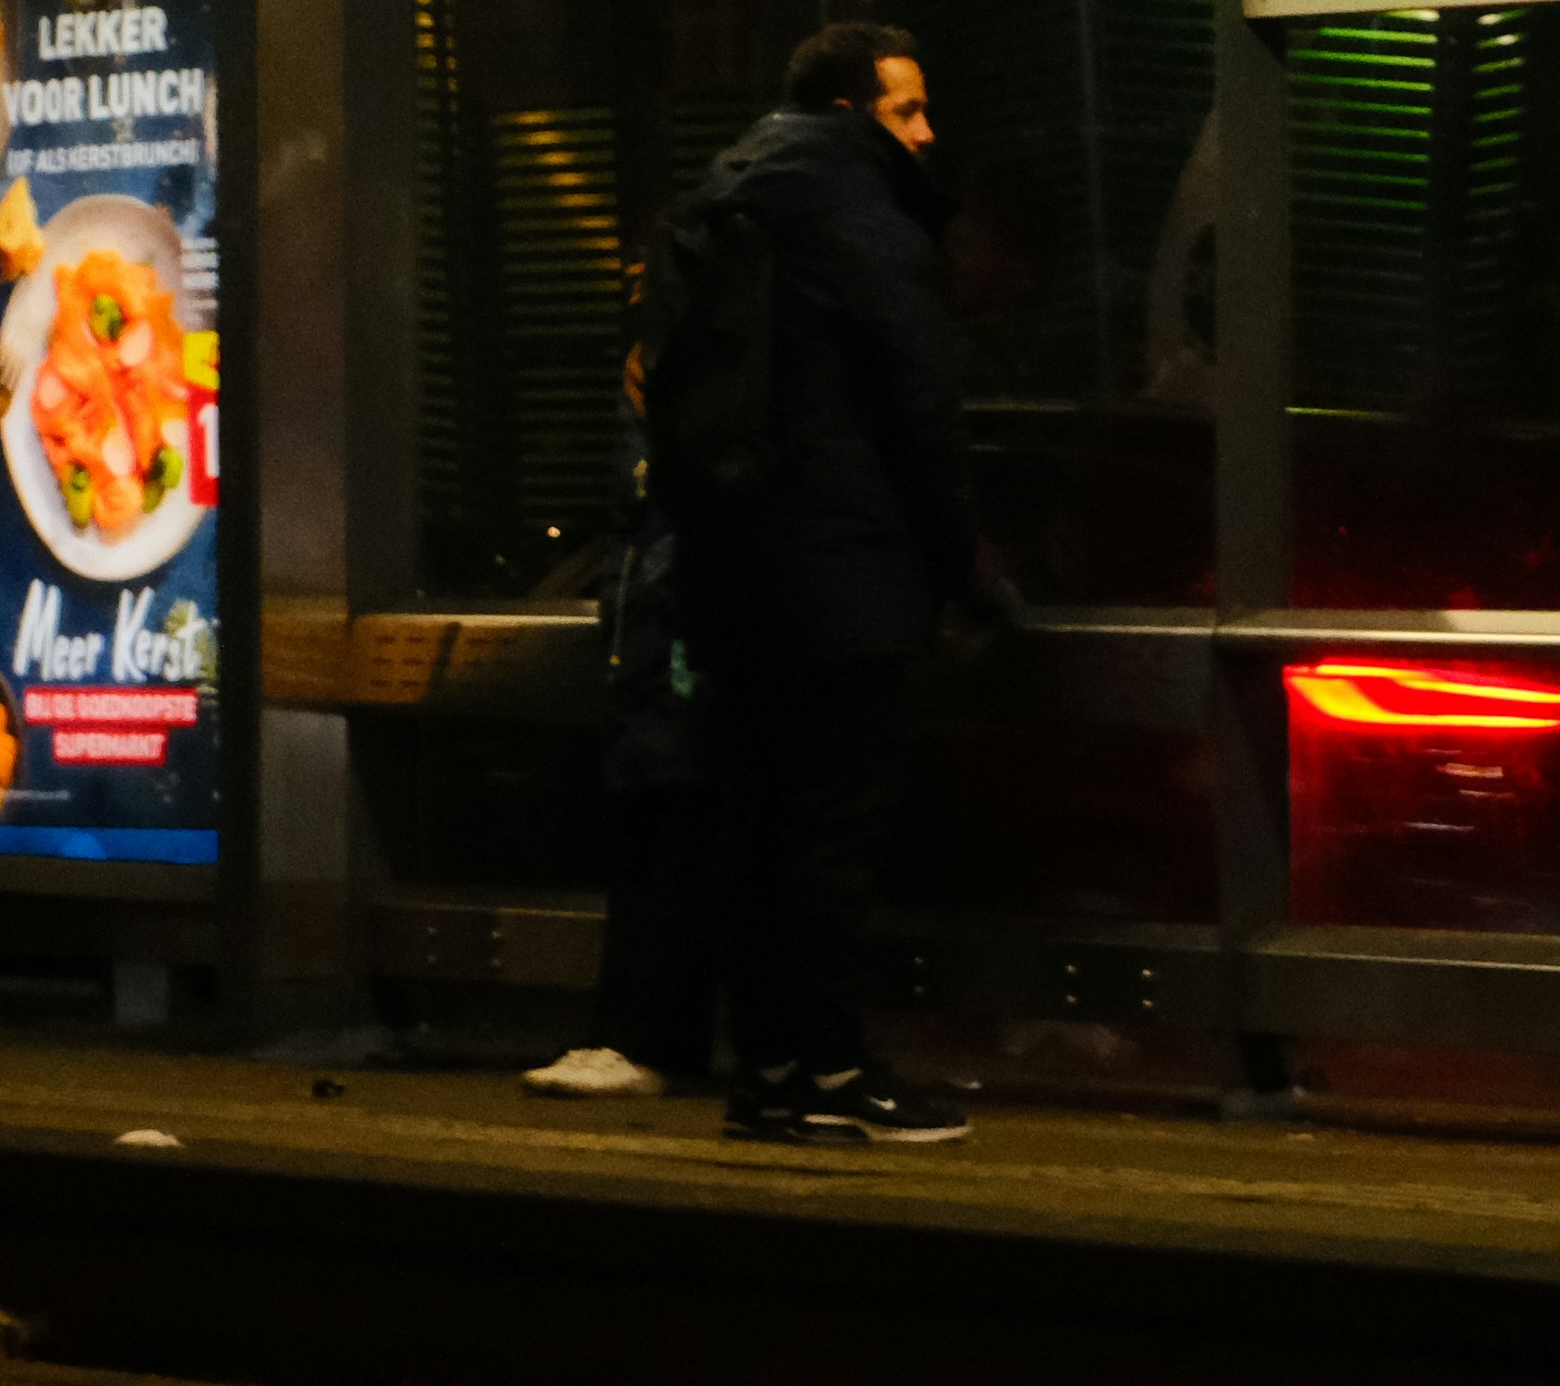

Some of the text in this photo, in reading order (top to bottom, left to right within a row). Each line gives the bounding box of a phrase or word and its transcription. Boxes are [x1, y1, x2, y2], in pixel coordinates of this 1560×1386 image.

[39, 6, 168, 61] LEKKER
[1, 68, 205, 127] VOOR LUNCH
[13, 578, 105, 681] Meer
